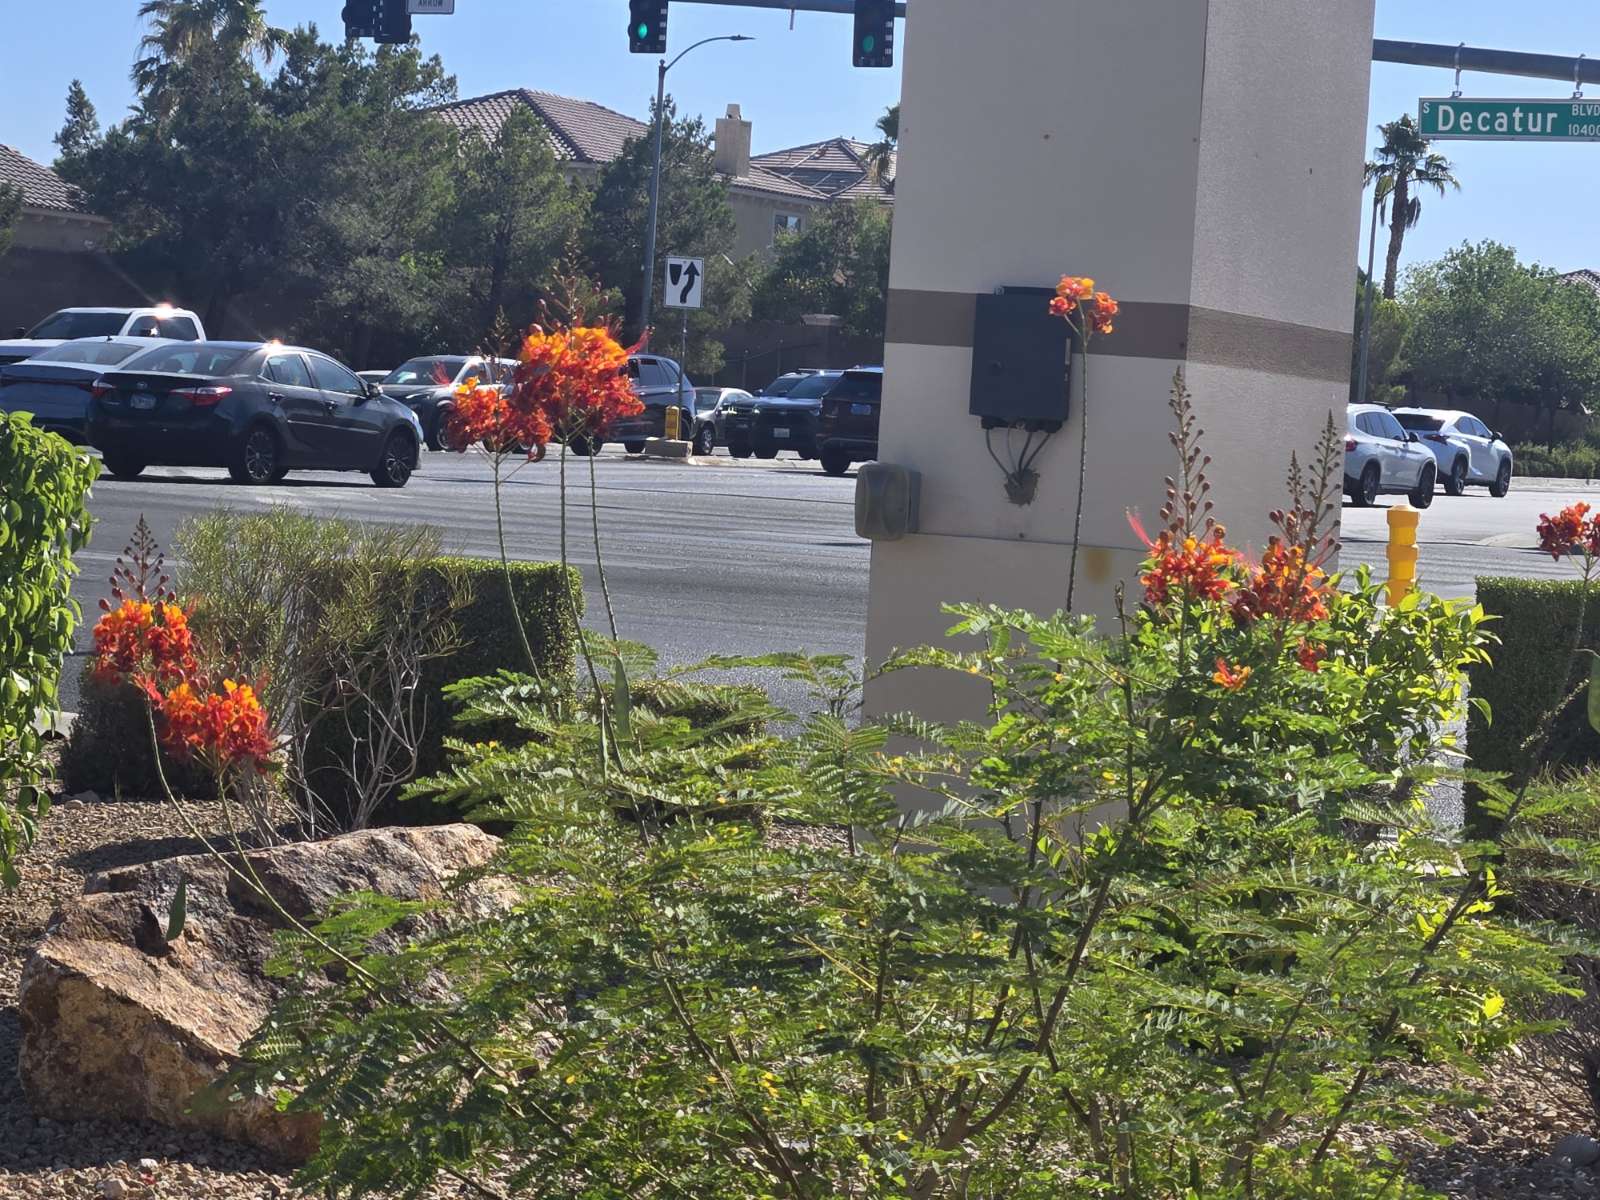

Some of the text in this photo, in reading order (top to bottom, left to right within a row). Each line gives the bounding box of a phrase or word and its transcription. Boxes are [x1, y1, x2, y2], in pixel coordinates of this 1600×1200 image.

[1422, 102, 1600, 132] S Decatur BLVD
